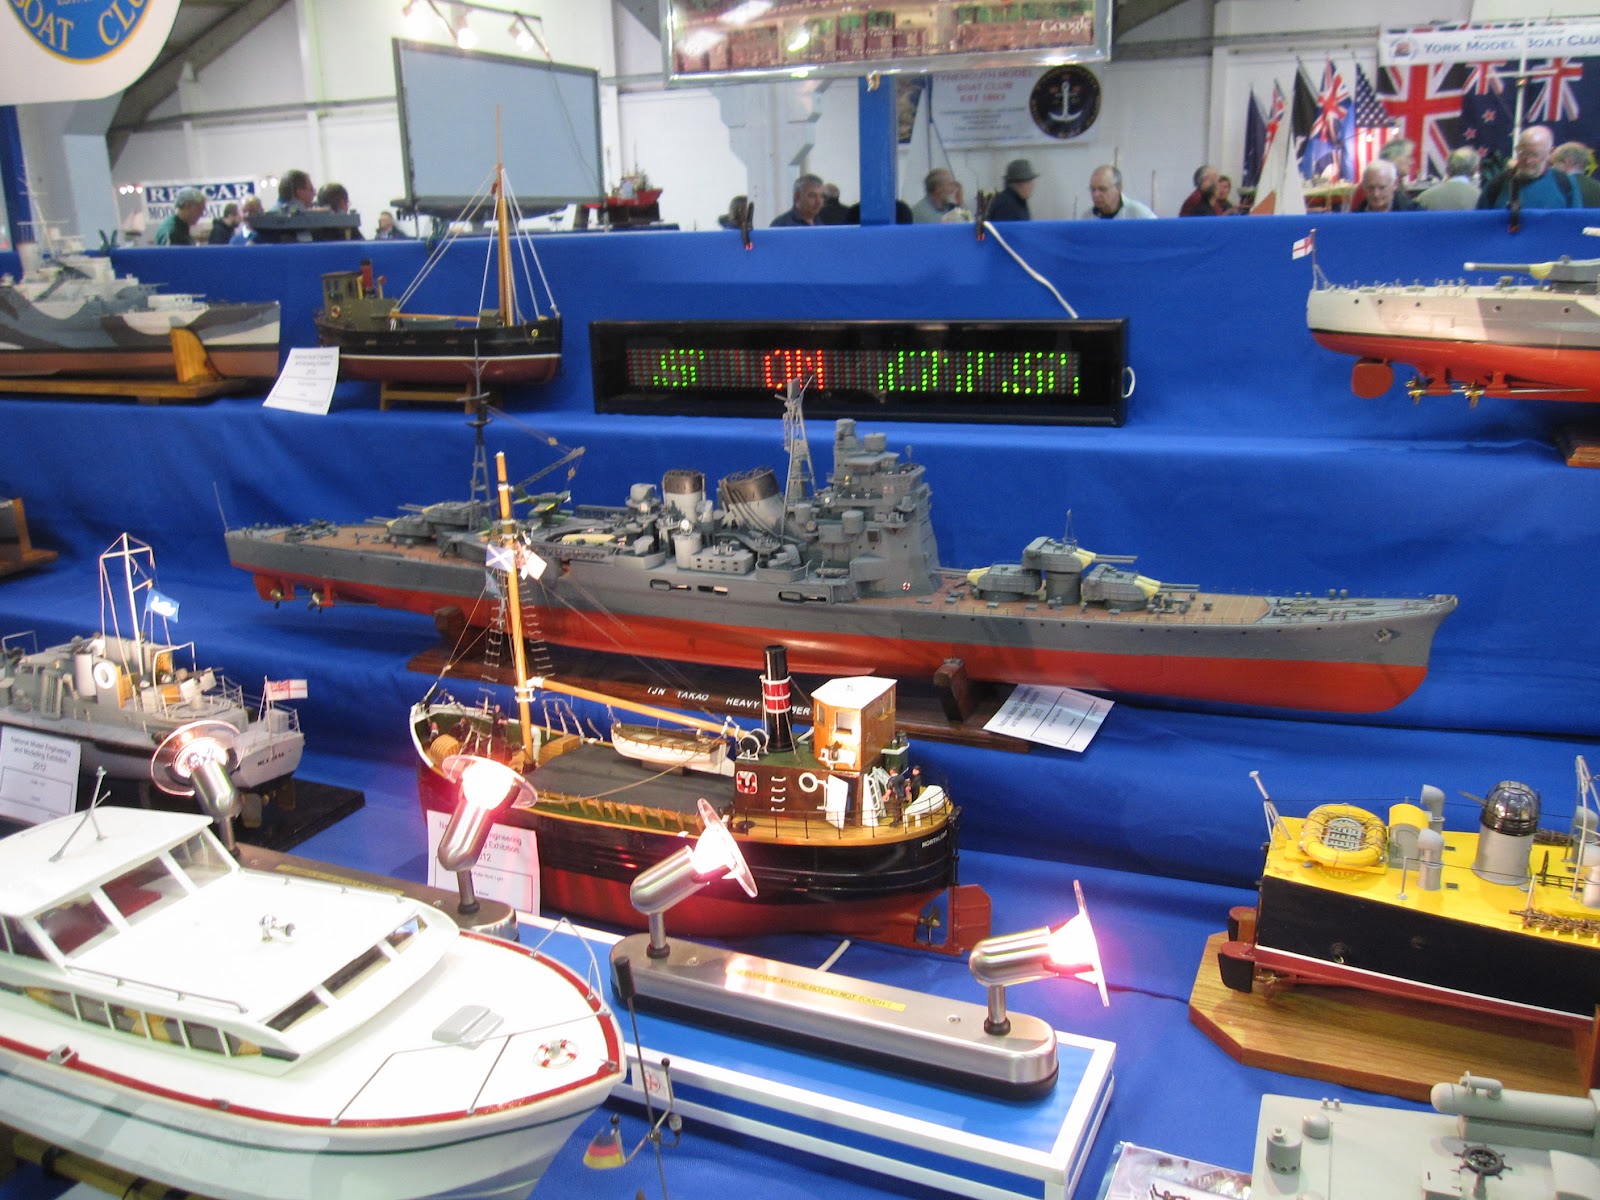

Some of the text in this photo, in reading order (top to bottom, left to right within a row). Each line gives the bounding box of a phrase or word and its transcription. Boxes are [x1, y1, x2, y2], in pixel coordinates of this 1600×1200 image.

[1040, 16, 1092, 35] Google
[1423, 42, 1464, 55] YORK
[1466, 39, 1519, 50] MODEL
[150, 182, 249, 202] RECAR
[647, 686, 761, 709] IJN TAKAO HEAVY
[490, 832, 522, 847] ngineering
[780, 977, 797, 987] MAY
[809, 985, 826, 994] HOT
[826, 988, 839, 998] DO
[839, 991, 858, 1000] NOT
